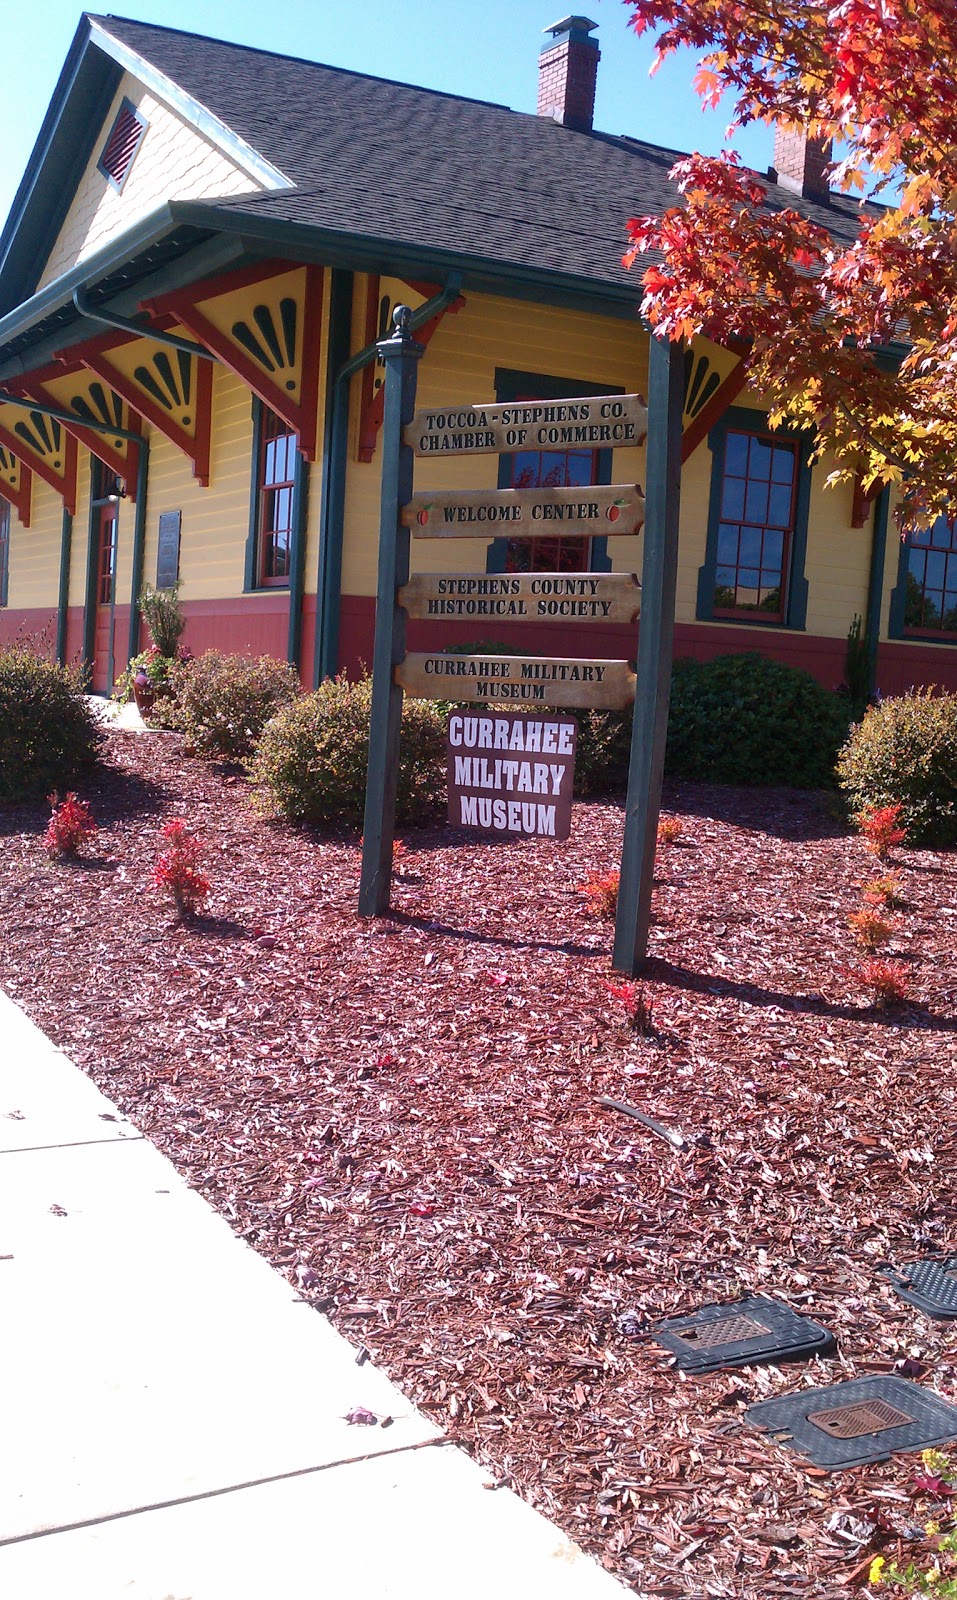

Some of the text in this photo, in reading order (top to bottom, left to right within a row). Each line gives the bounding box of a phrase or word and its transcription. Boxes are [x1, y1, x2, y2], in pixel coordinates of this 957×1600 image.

[600, 402, 628, 419] CO.
[419, 423, 635, 451] CHAMBER OF COMMERCE
[443, 503, 599, 523] WELCOME CENTER
[438, 579, 600, 596] STEPHENS COUNTY
[427, 599, 612, 617] HISTORICAL SOCIETY
[424, 659, 606, 682] CURRAHEE MILITARY
[476, 681, 546, 700] MUSEUM
[450, 716, 574, 755] CURRAHEE
[454, 756, 565, 795] MILITARY
[460, 796, 556, 836] MUSEUM
